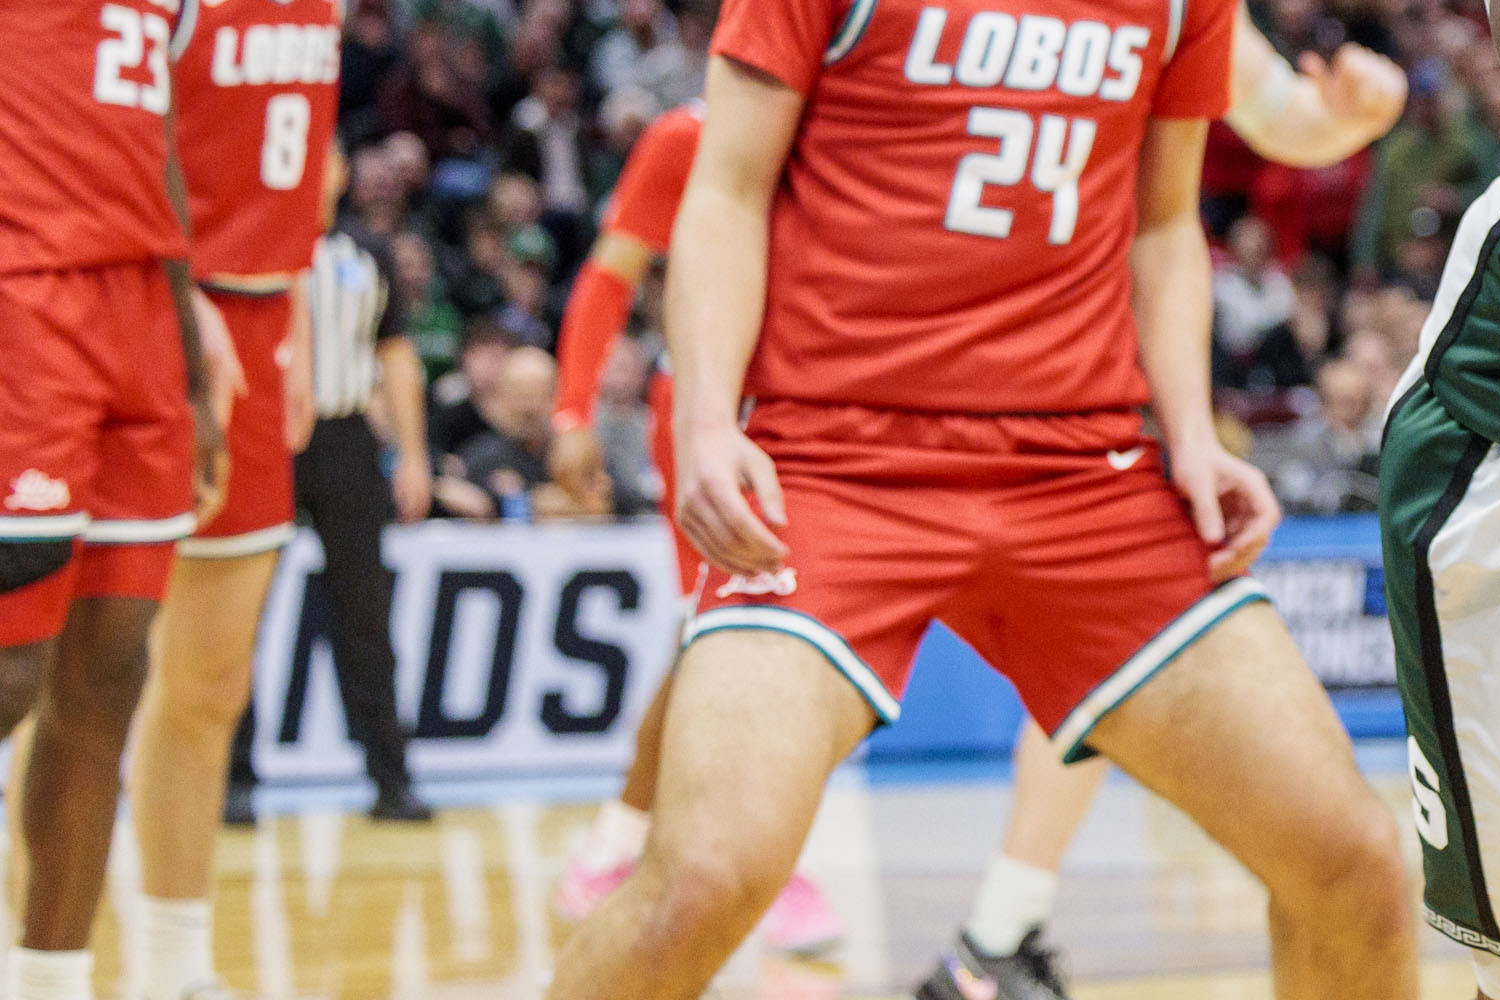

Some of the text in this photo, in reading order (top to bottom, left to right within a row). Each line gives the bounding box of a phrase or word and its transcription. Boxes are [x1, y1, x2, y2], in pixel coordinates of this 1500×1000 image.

[93, 3, 171, 116] 23
[211, 23, 340, 87] LOBOS
[904, 7, 1151, 101] LOBOS
[259, 92, 311, 190] 8
[943, 106, 1096, 245] 24
